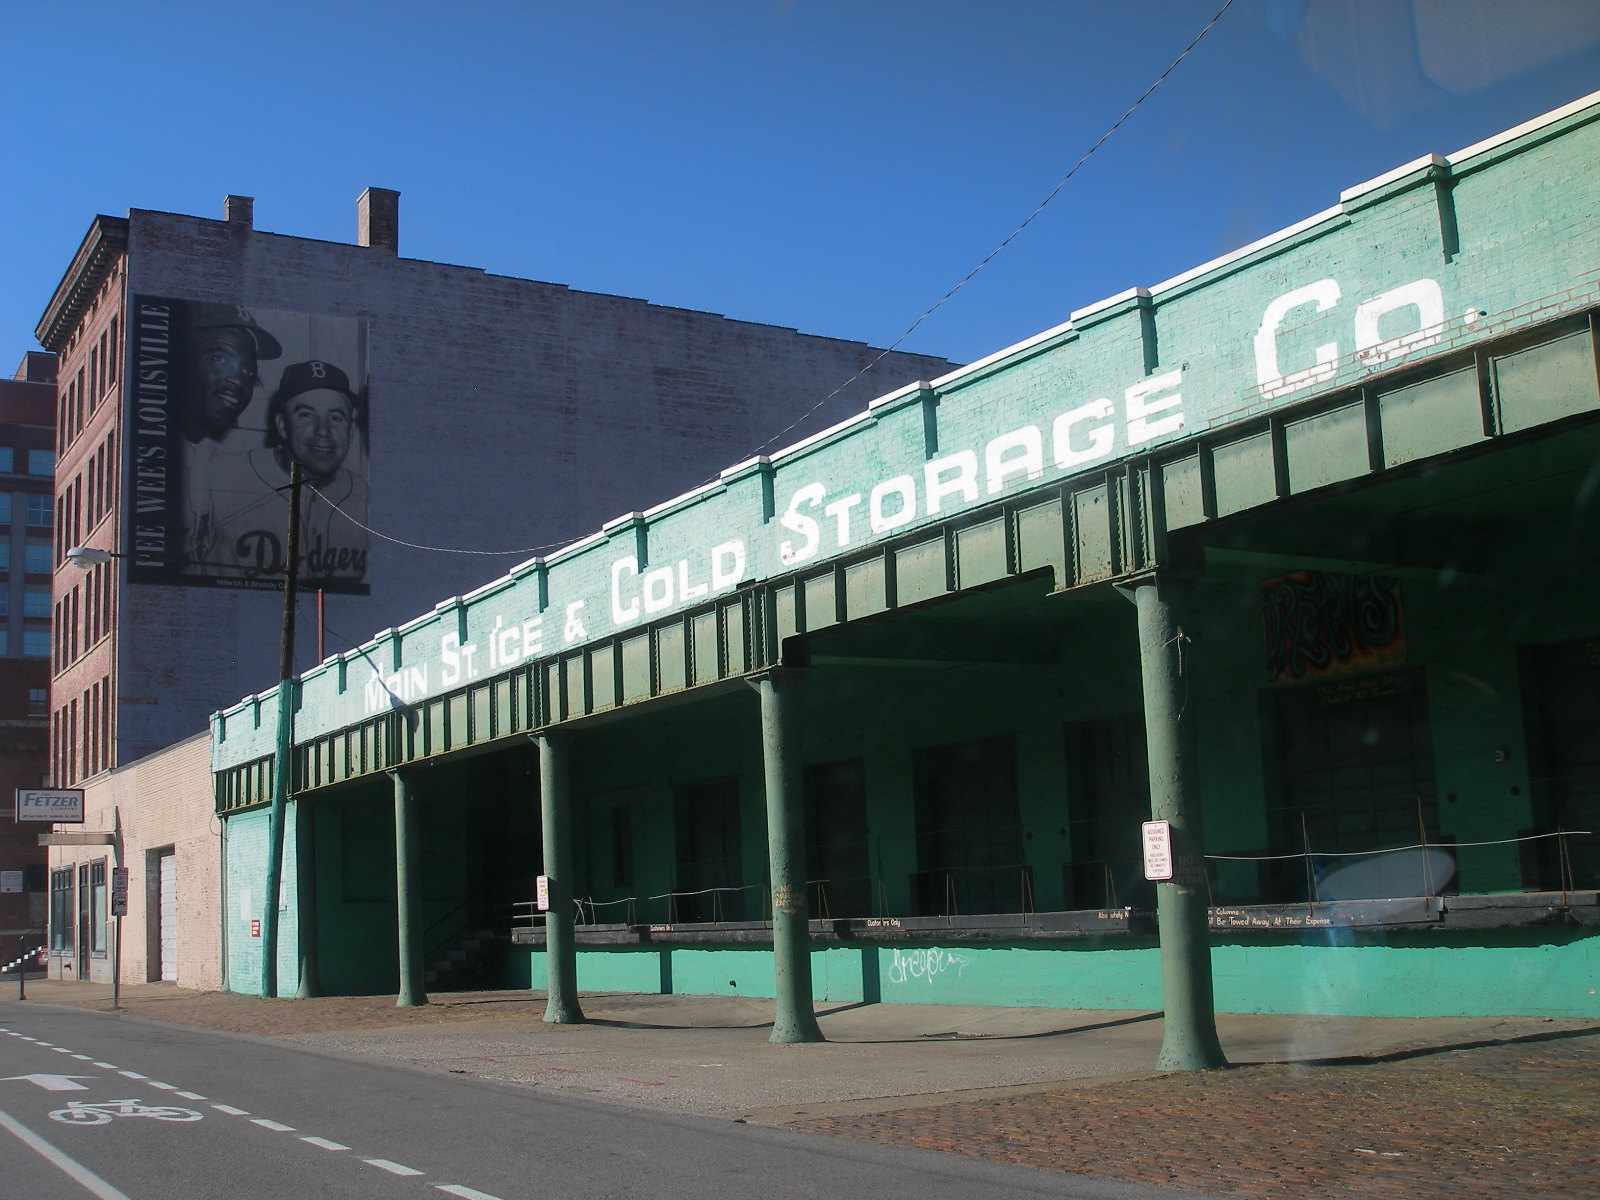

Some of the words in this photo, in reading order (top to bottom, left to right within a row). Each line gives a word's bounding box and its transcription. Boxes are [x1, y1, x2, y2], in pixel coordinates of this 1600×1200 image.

[138, 304, 170, 437] LOUISVILLE
[310, 360, 326, 378] B
[136, 446, 167, 513] WEE'S
[490, 614, 543, 671] ICE
[563, 600, 588, 643] &
[611, 539, 746, 626] COLD
[779, 368, 1186, 567] STORAGE
[136, 525, 165, 567] PEE
[236, 530, 368, 577] Ddgers
[23, 792, 78, 807] FETZER
[1216, 917, 1226, 926] Be
[1228, 916, 1249, 926] Towed
[1251, 917, 1270, 928] Away
[1285, 917, 1302, 925] Their
